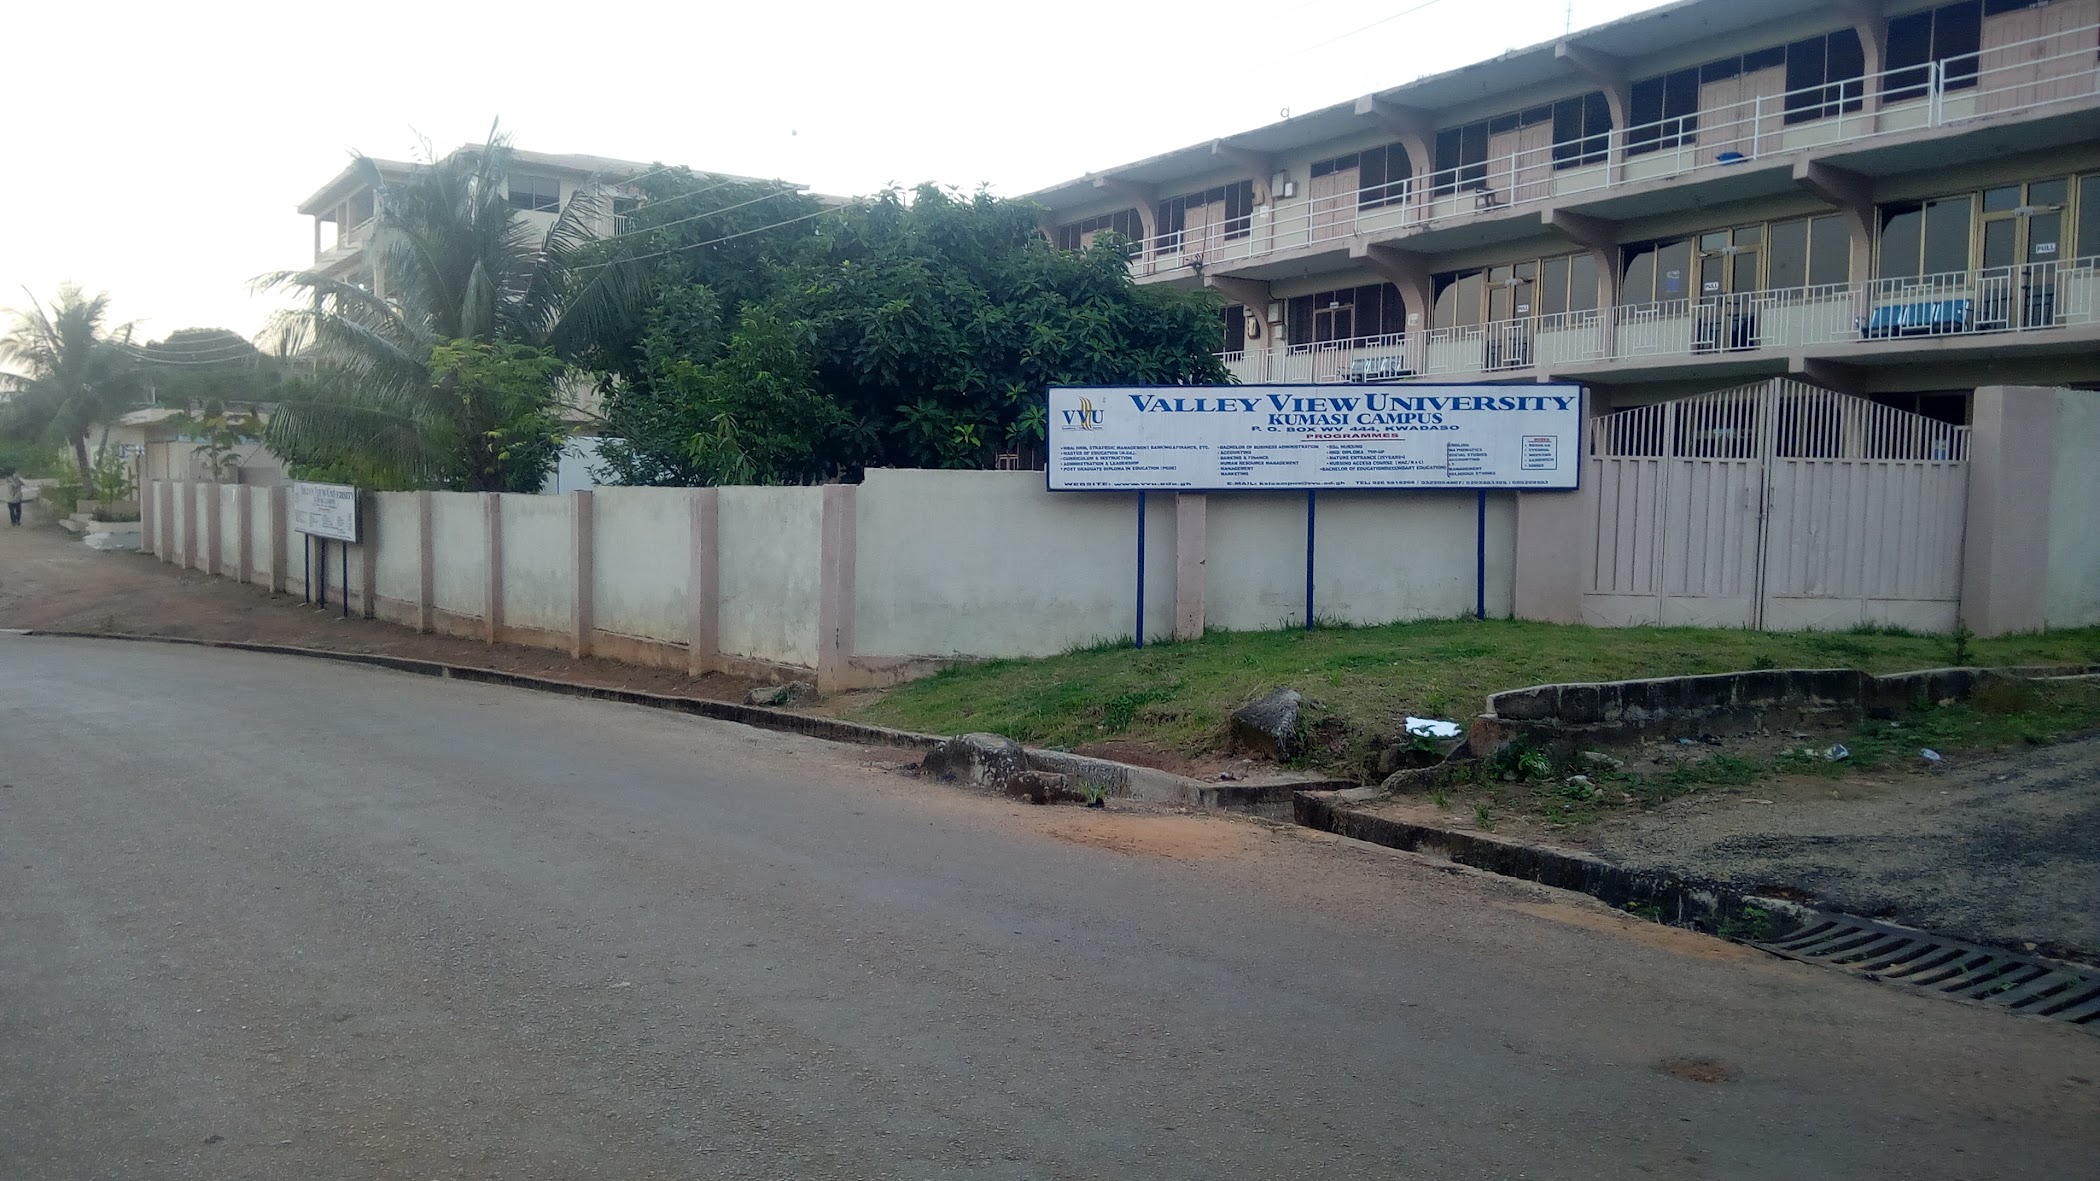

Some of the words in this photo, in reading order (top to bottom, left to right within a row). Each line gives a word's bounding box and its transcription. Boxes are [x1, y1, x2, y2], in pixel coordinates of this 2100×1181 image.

[2036, 244, 2055, 252] PULL
[1128, 394, 1262, 413] VALLEY
[1266, 393, 1361, 412] VIEW
[1364, 393, 1576, 412] UNIVERSITY
[1061, 409, 1104, 425] VVU
[1268, 413, 1350, 426] KUMASI
[1356, 412, 1443, 425] CAMPUS
